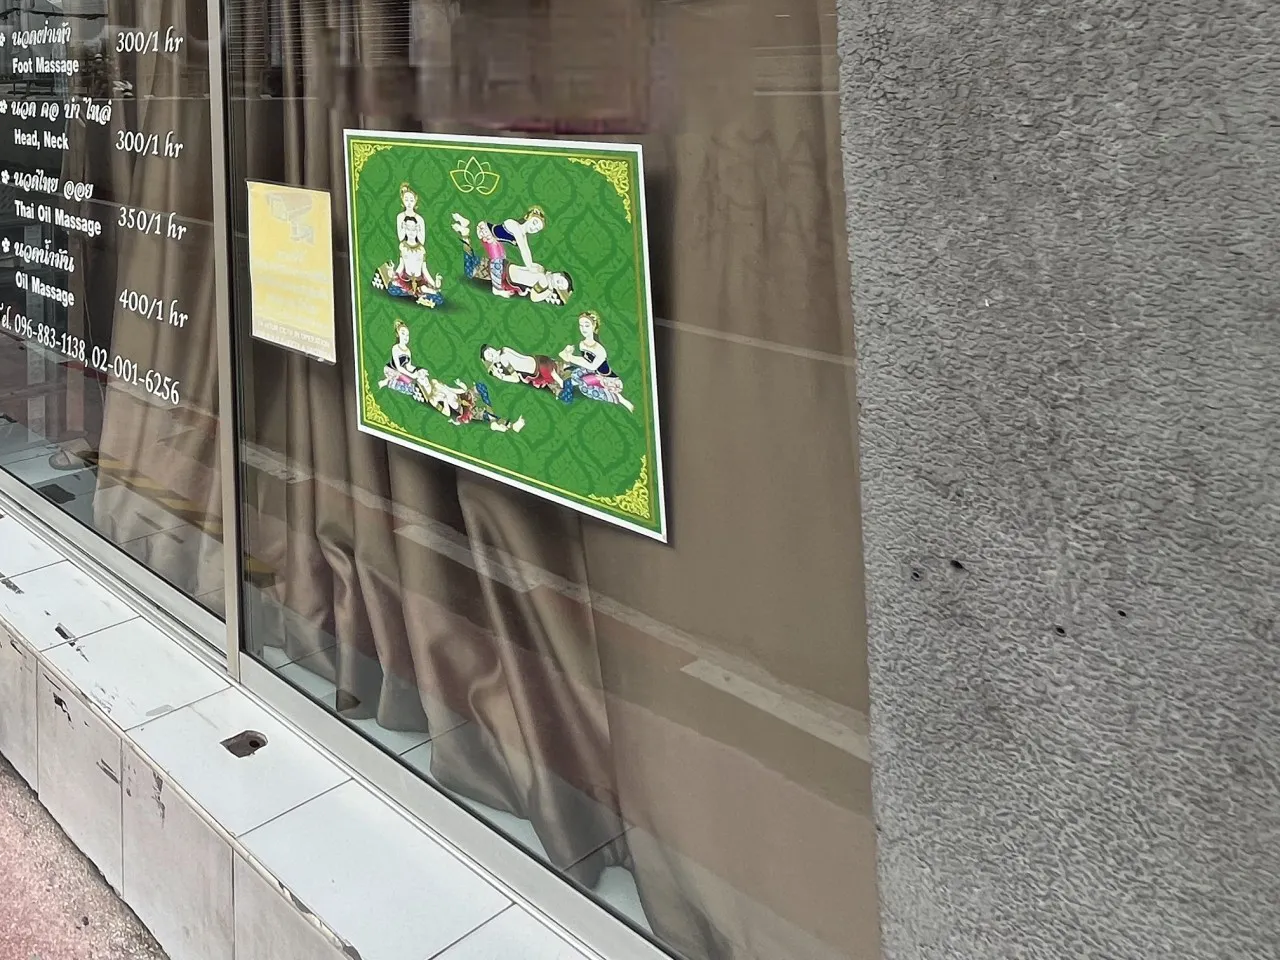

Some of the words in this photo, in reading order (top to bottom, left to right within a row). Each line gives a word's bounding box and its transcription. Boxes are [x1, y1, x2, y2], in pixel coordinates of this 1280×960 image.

[11, 20, 71, 49] นวดฝ่าเท้า
[116, 32, 158, 54] 300/1
[164, 26, 183, 53] hr
[12, 58, 33, 74] Foot
[36, 57, 79, 77] Massage
[11, 101, 37, 120] นวด
[40, 102, 60, 121] คอ
[63, 97, 80, 119] บ่า
[83, 97, 112, 125] ไหล่
[14, 128, 40, 150] Head,
[44, 130, 69, 150] Neck
[116, 130, 159, 156] 300/1
[164, 131, 183, 158] hr
[13, 169, 59, 193] นวดไทย
[14, 200, 34, 219] Thai
[37, 204, 51, 223] Oil
[54, 208, 101, 237] Massage
[118, 206, 161, 235] 350/1
[167, 212, 186, 240] hr
[13, 239, 74, 272] นวดน้ำมัน
[15, 271, 28, 290] Oil
[31, 276, 74, 307] Massage
[119, 289, 163, 321] 400/1
[169, 300, 188, 328] hr
[14, 316, 89, 367] 096-883-1138,
[92, 345, 180, 405] 02-001-6256
